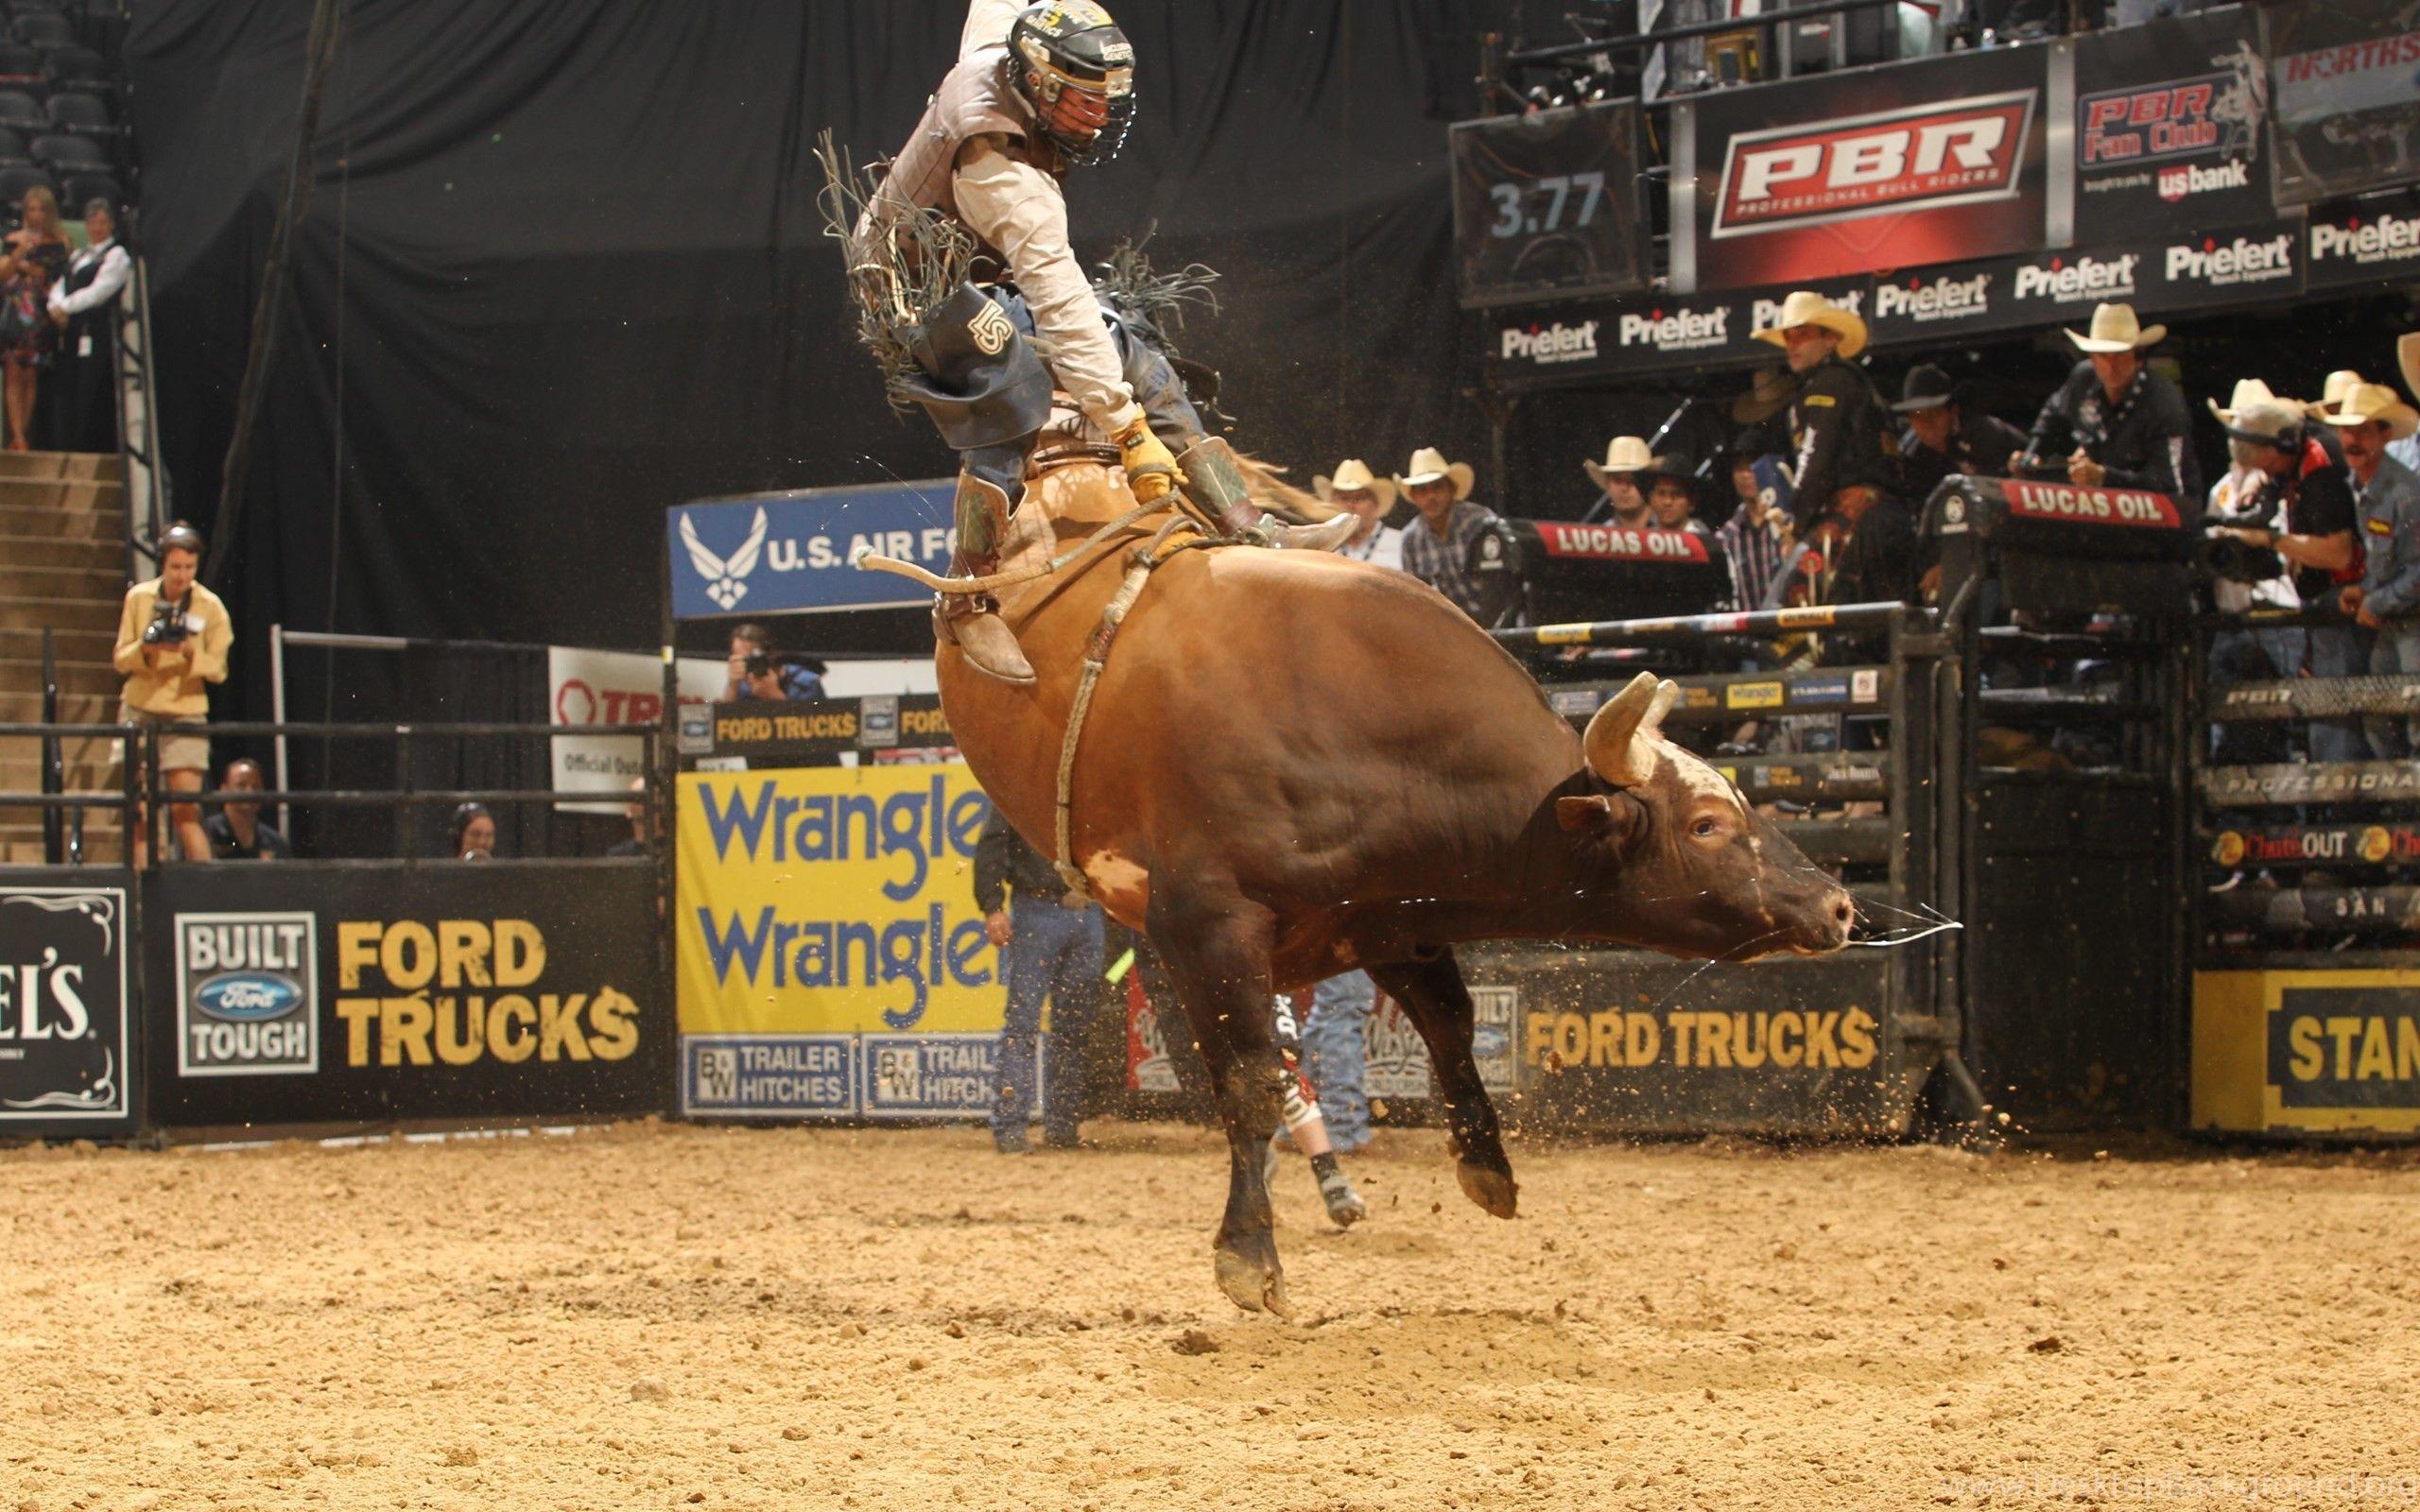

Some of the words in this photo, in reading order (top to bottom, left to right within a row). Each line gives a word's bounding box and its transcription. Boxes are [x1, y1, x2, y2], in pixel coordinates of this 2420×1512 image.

[2086, 83, 2213, 130] PBR
[1738, 115, 2006, 201] PBR
[2084, 130, 2142, 163] Fan
[2149, 115, 2218, 153] Club
[1490, 171, 1604, 239] 3.77
[1736, 189, 1868, 215] PROFESSIONAL
[1876, 178, 1920, 197] BULL
[1928, 167, 2000, 187] RIDERS
[2014, 253, 2135, 300] Priefert
[2166, 233, 2290, 281] Priefert
[1876, 273, 1986, 318] Priefert
[1501, 321, 1597, 359] Priefert
[1619, 306, 1728, 346] Priefert
[2019, 486, 2111, 517] LUCAS
[2120, 494, 2162, 520] OIL
[767, 535, 842, 572] U.S.
[846, 530, 914, 567] AIR
[1557, 526, 1641, 554] LUCAS
[1648, 532, 1691, 557] OIL
[717, 717, 772, 742] FORD
[774, 713, 857, 740] TRUCKS
[901, 709, 952, 735] FOR
[698, 774, 991, 902] Wrangle
[189, 924, 305, 971] BUILT
[337, 919, 547, 990] FORD
[219, 981, 276, 1008] Ford
[191, 1022, 306, 1060] TOUGH
[741, 1046, 840, 1072] TRAILER
[1525, 1007, 1661, 1069] FORD
[2289, 1015, 2420, 1082] STAN
[741, 1076, 843, 1104] HITCHES
